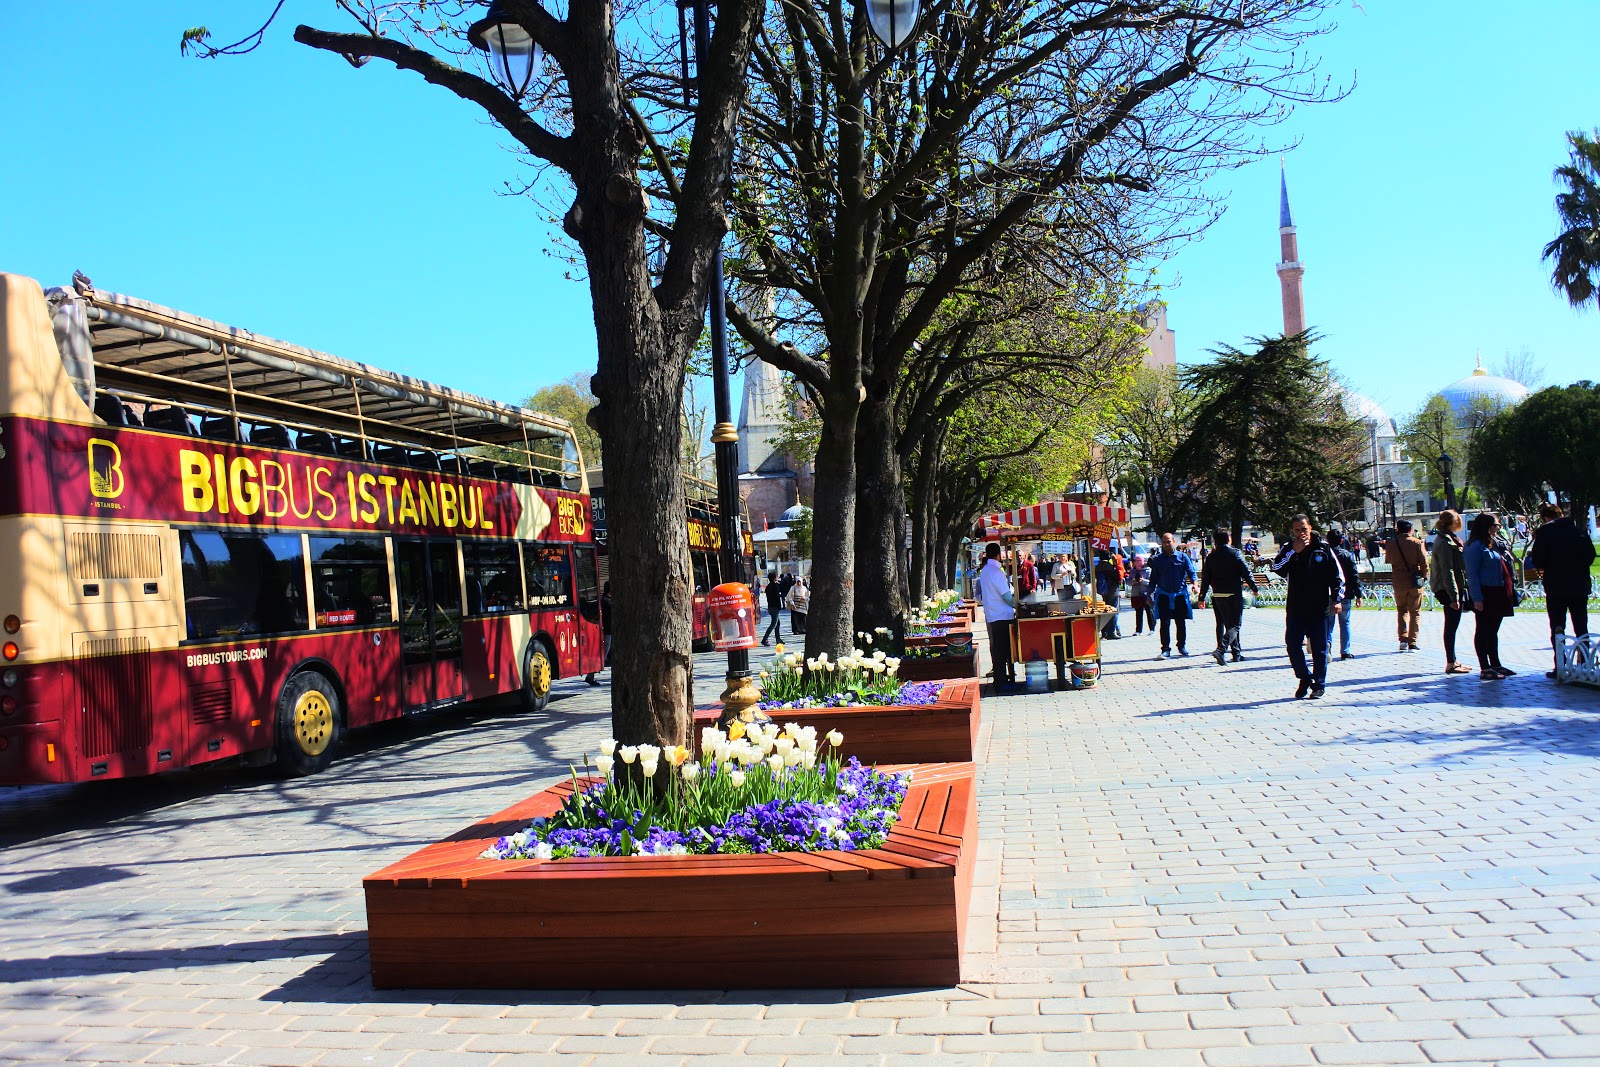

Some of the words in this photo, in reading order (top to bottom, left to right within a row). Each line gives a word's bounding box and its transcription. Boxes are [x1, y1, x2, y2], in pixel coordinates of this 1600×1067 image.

[94, 501, 122, 510] ISTANBUL
[347, 470, 494, 530] ISTANBUL
[557, 496, 573, 516] BIG
[592, 510, 606, 522] BU
[558, 516, 575, 535] BUS
[1091, 537, 1101, 549] 2
[1100, 543, 1108, 551] TL
[328, 615, 339, 623] RED
[340, 614, 355, 622] ROUTE
[186, 647, 268, 668] BIGBUSTOURS.COM
